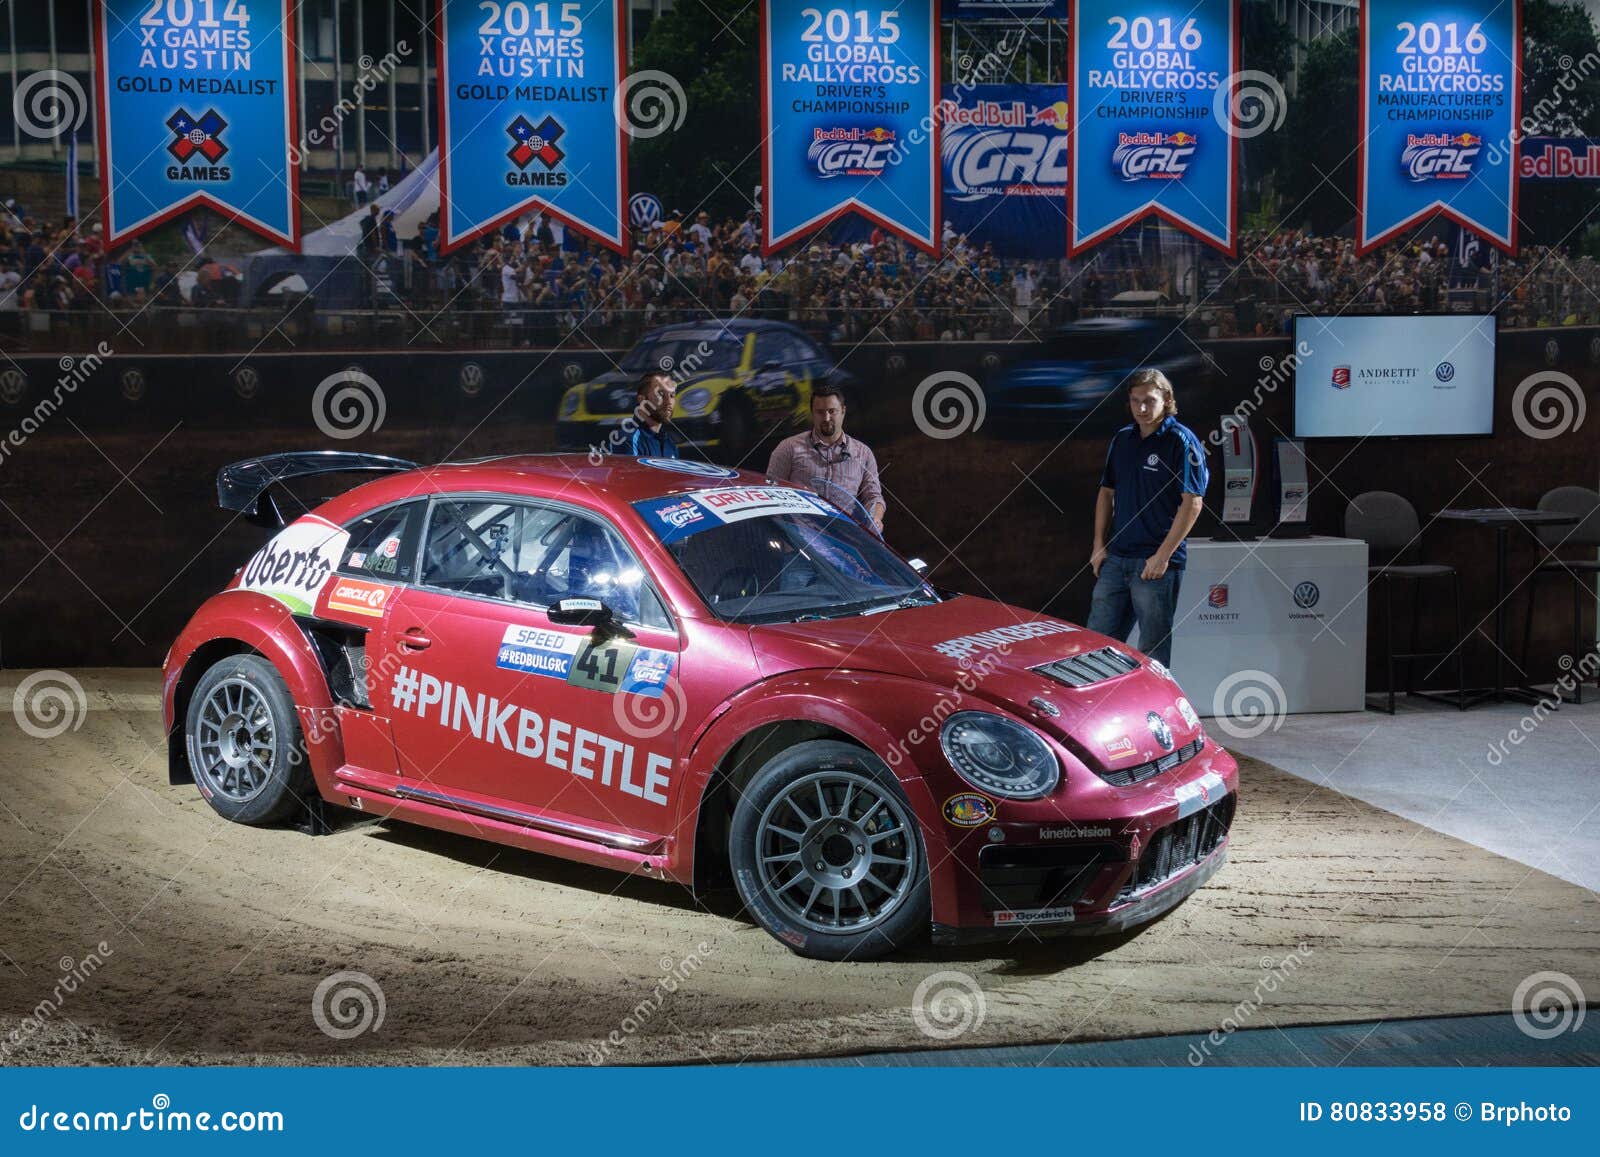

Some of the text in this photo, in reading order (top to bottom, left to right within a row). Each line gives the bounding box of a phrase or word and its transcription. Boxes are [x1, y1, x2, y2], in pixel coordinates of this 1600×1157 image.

[139, 0, 250, 28] 2014
[479, 1, 582, 37] 2015
[801, 8, 900, 44] 2015
[1107, 16, 1202, 51] 2016
[141, 28, 250, 50] X GAMES
[480, 37, 584, 57] X GAMES
[1396, 22, 1487, 54] 2016
[139, 49, 250, 70] AUSTIN
[808, 44, 895, 64] GLOBAL
[1113, 51, 1196, 70] GLOBAL
[1402, 55, 1482, 73] GLOBAL
[478, 57, 584, 78] AUSTIN
[782, 63, 920, 84] RALLYCROSS
[117, 76, 277, 95] GOLD MEDALIST
[1088, 70, 1219, 90] RALLYCROSS
[1379, 74, 1504, 92] RALLYCROSS
[456, 84, 609, 103] GOLD MEDALIST
[816, 85, 886, 98] DRIVER'S
[1120, 91, 1186, 104] DRIVER'S
[1377, 94, 1504, 106] MANUFACTURER'S
[792, 100, 910, 114] CHAMPIONSHIP
[1097, 105, 1209, 119] CHAMPIONSHIP
[1387, 109, 1494, 121] CHAMPIONSHIP
[823, 143, 894, 169] GRC
[1127, 148, 1195, 173] GRC
[1415, 148, 1480, 174] GRC
[166, 166, 231, 181] GAMES
[506, 172, 567, 186] GAMES
[1358, 368, 1418, 378] ANDRETTI
[336, 587, 369, 601] CIRCLE
[516, 630, 565, 649] SPEED
[500, 650, 567, 673] #REDBULLGRC
[577, 645, 619, 685] 41
[391, 666, 672, 806] #PINKBEETLE
